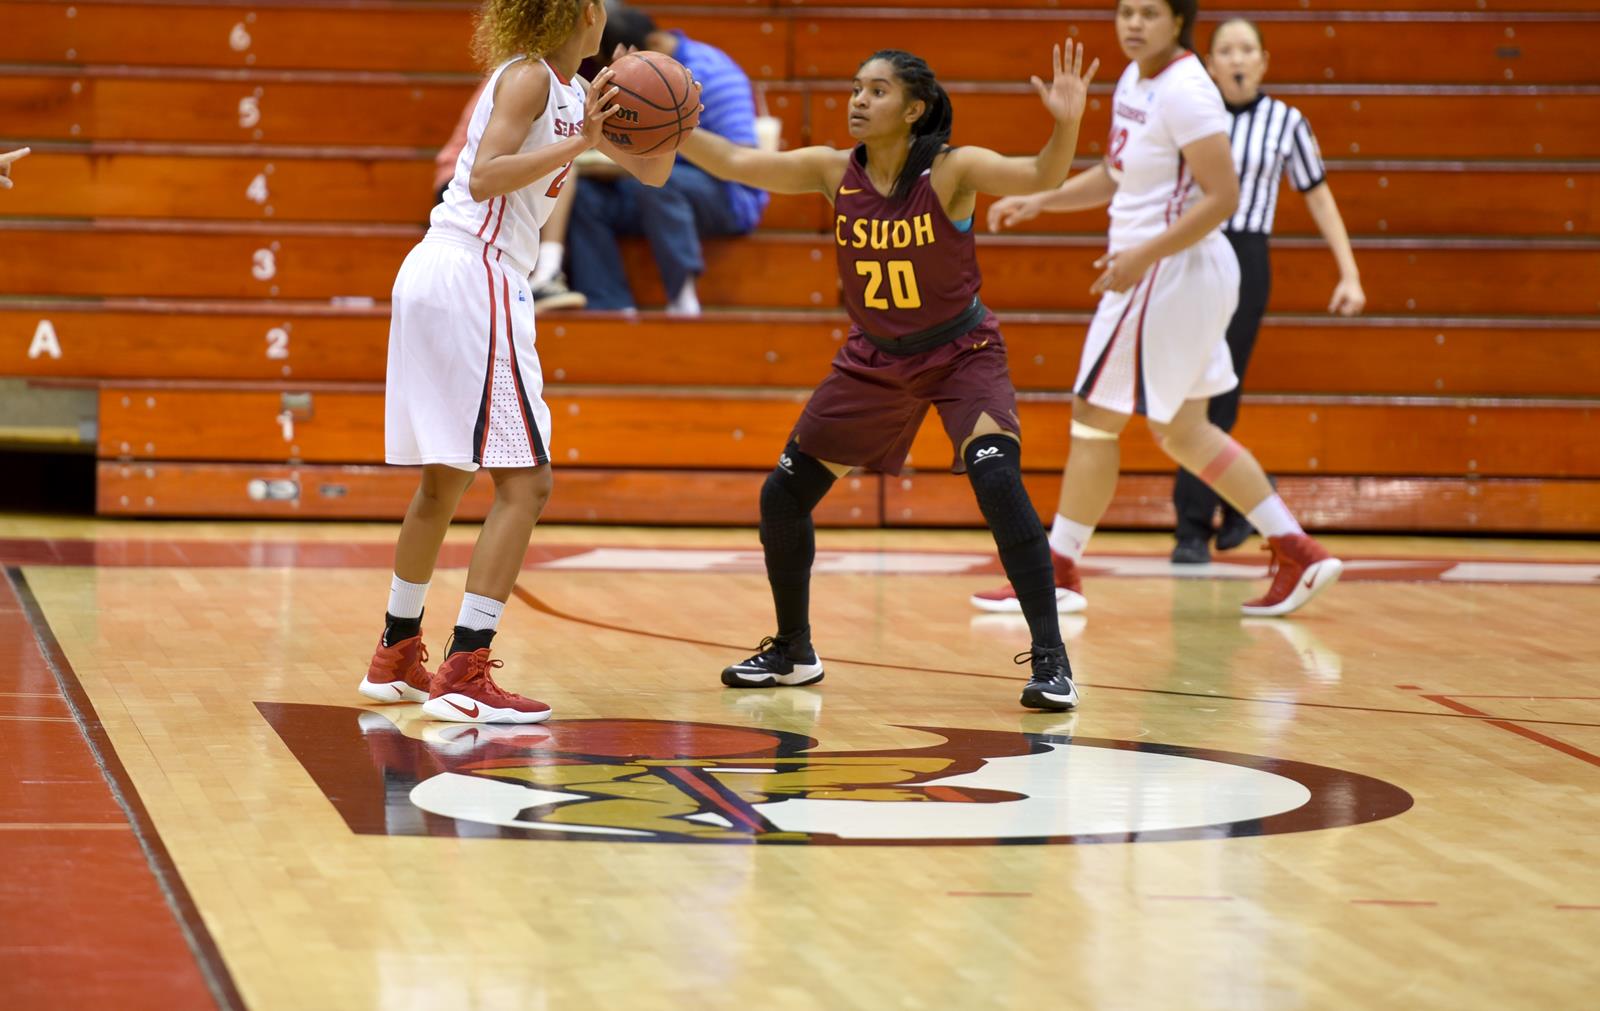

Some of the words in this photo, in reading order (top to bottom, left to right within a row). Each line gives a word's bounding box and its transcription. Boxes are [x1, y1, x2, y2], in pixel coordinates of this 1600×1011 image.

[230, 22, 252, 51] 6
[239, 96, 261, 128] 5
[246, 173, 269, 204] 4
[252, 249, 276, 280] 3
[855, 260, 922, 310] 20
[28, 319, 63, 359] A
[266, 328, 290, 359] 2
[276, 411, 294, 441] 1
